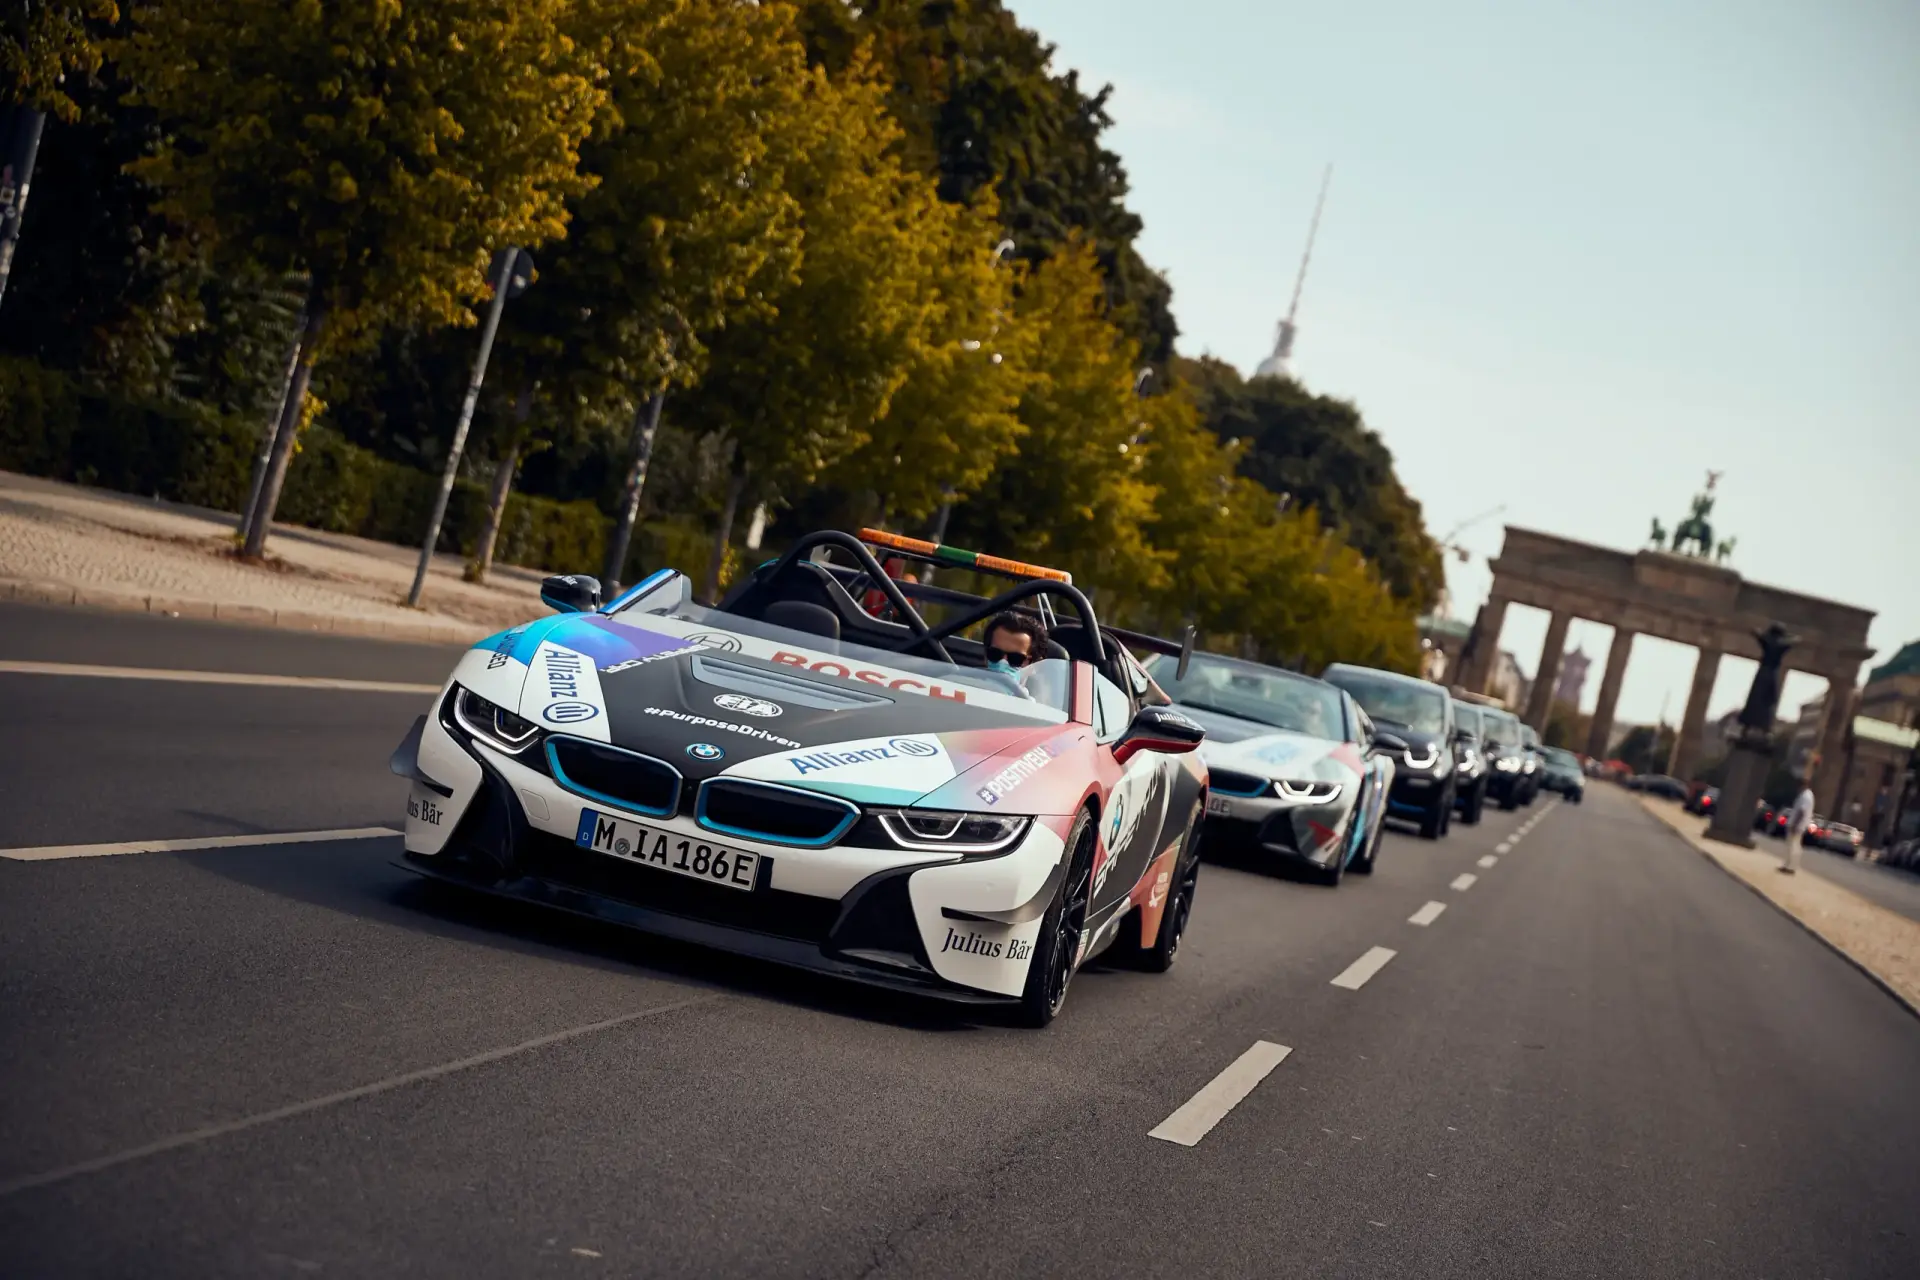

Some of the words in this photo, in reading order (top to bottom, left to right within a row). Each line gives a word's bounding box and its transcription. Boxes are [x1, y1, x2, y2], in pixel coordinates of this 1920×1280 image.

[544, 649, 582, 698] Allianz
[717, 695, 774, 717] FIA
[643, 707, 802, 749] #PurposeDriven
[785, 747, 899, 775] Allianz
[421, 799, 444, 826] Bär
[941, 927, 1003, 958] Julius
[1005, 939, 1033, 960] Bär
